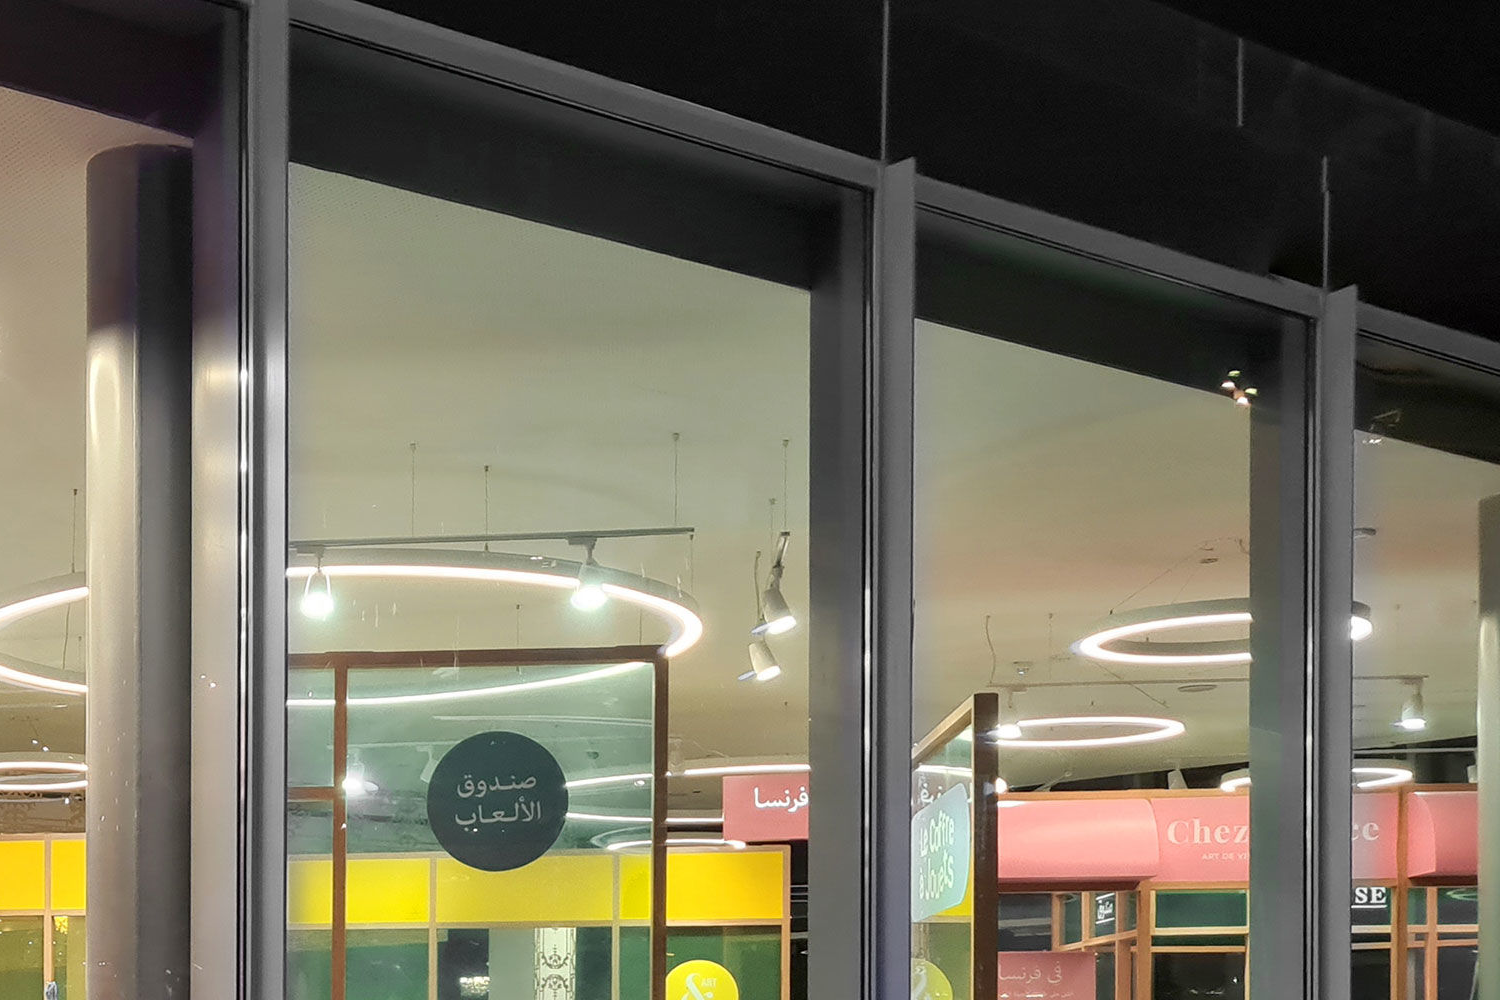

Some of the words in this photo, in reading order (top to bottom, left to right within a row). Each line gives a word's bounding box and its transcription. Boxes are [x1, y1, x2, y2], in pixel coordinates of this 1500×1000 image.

[457, 774, 537, 798] صندوق
[754, 786, 809, 812] فرنسا
[455, 796, 541, 833] الألعاب
[929, 809, 955, 853] Coffre
[1167, 817, 1249, 845] Chez
